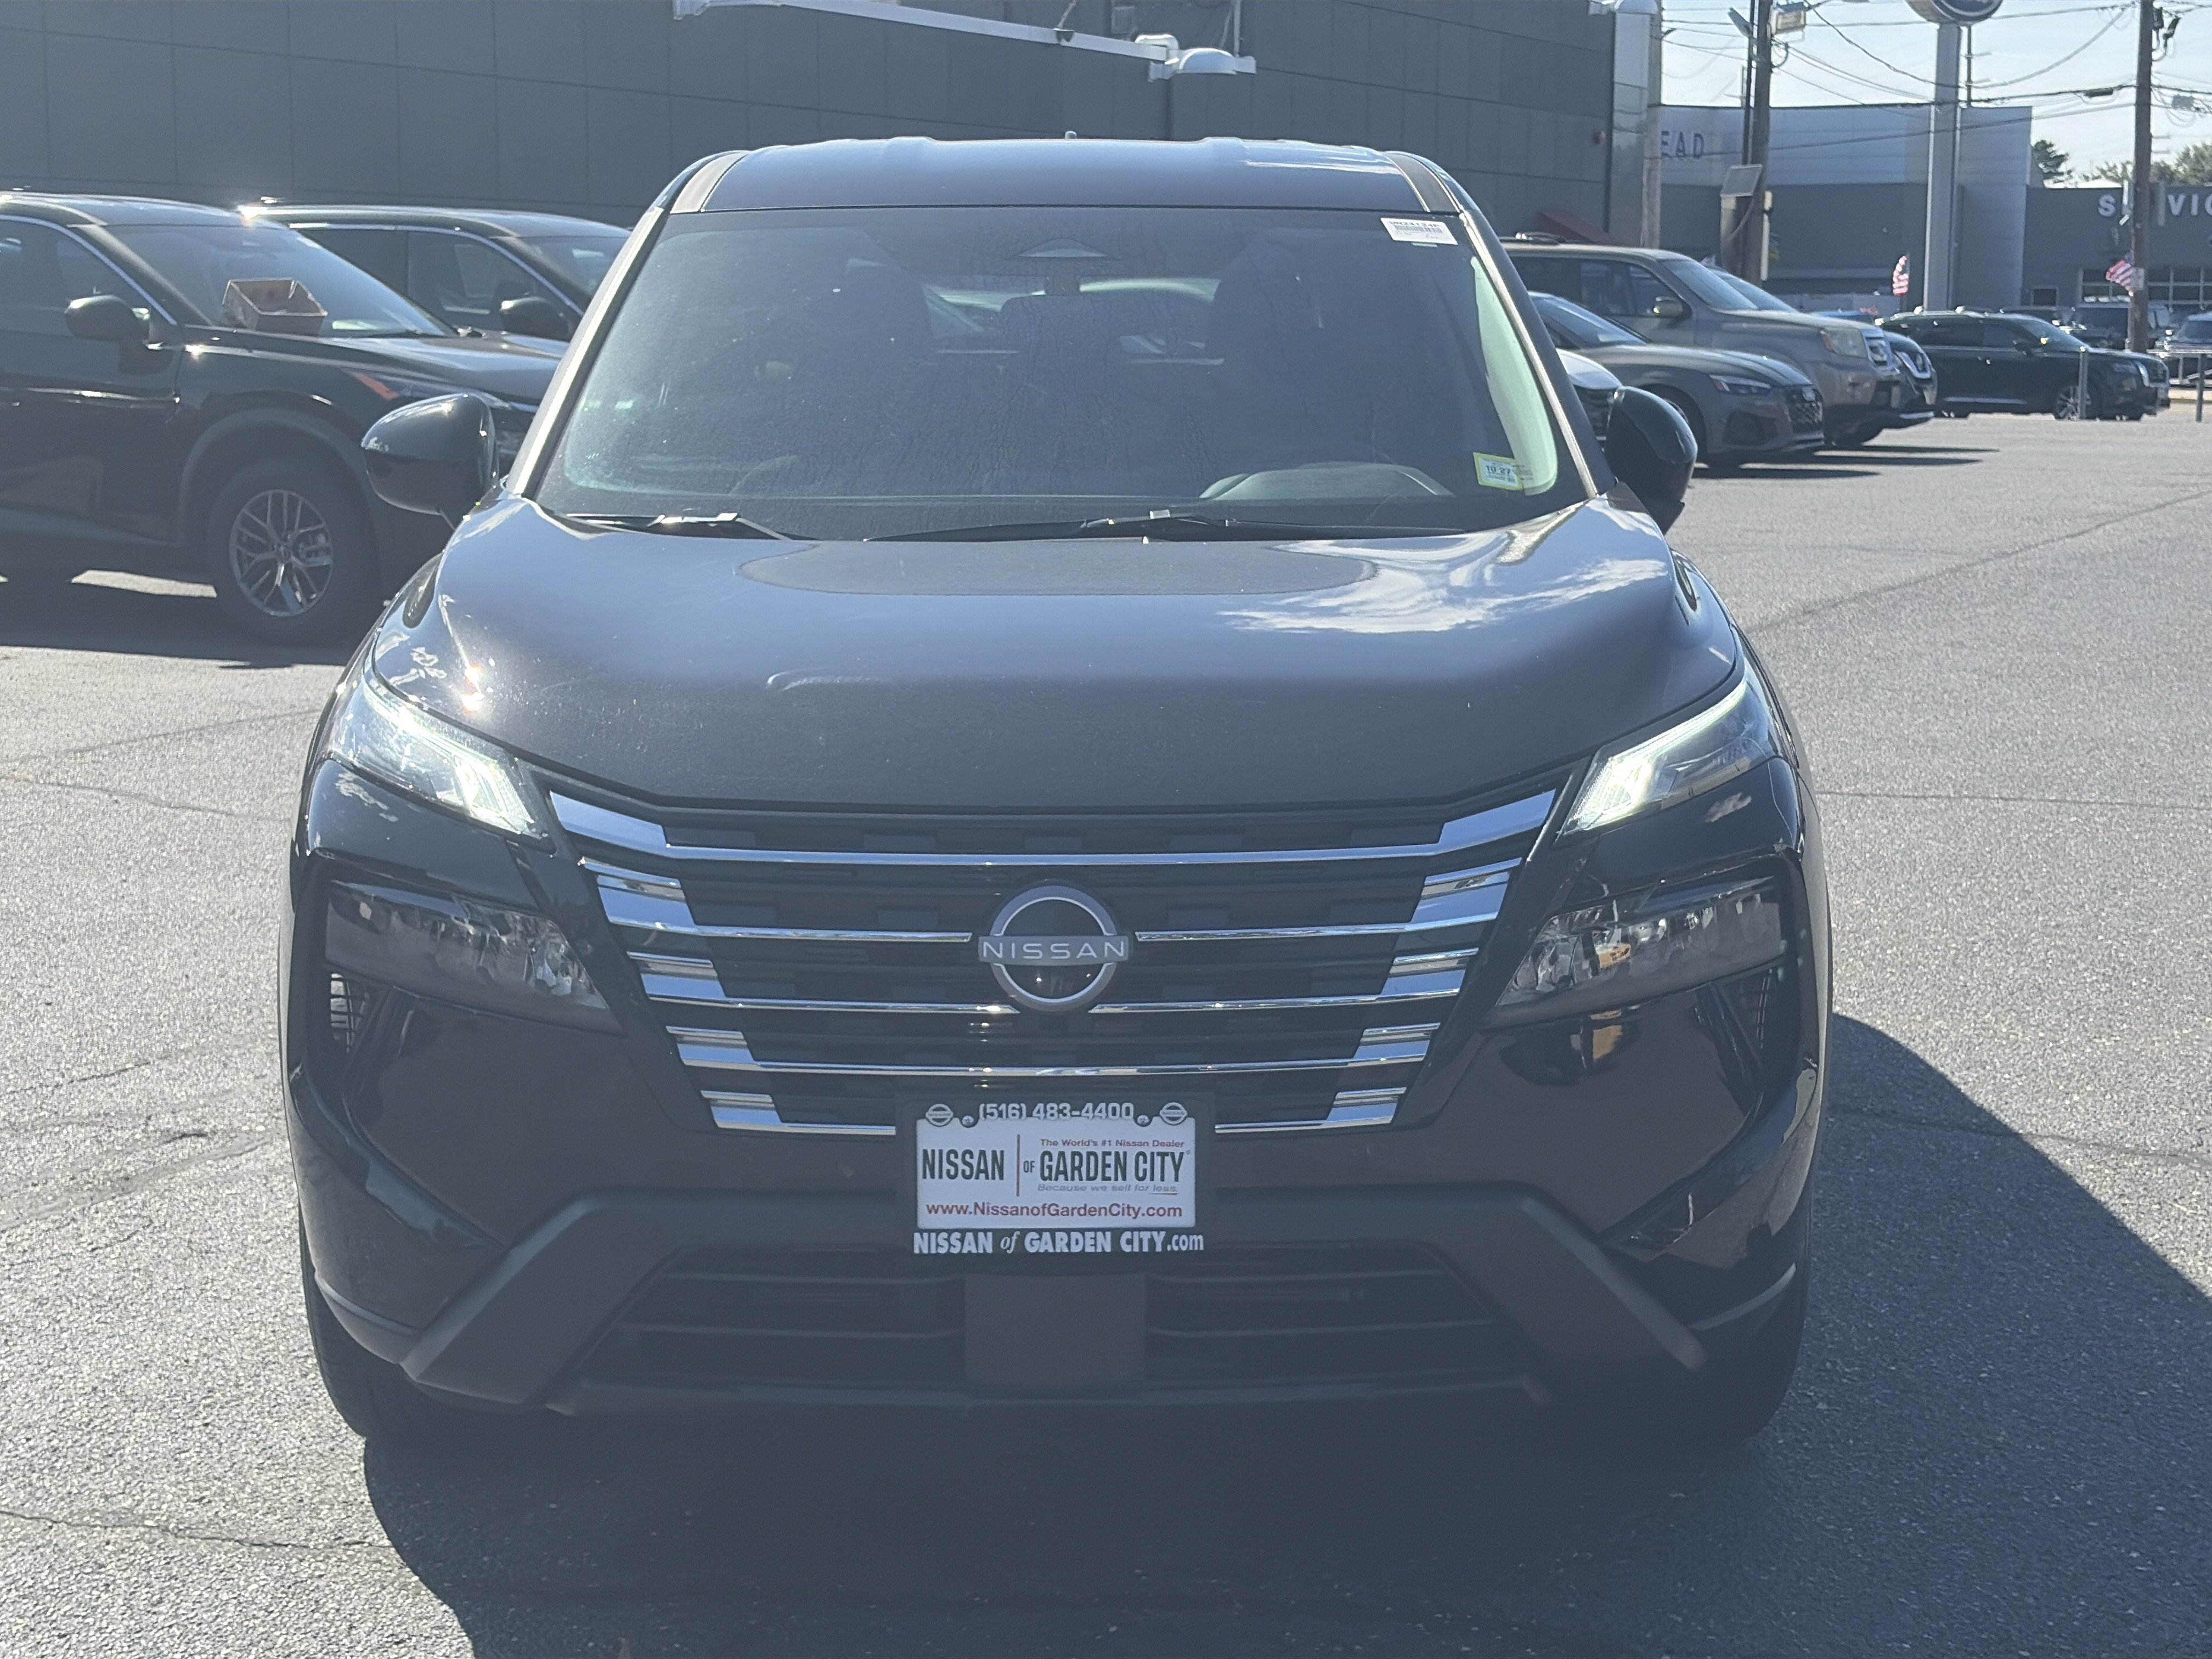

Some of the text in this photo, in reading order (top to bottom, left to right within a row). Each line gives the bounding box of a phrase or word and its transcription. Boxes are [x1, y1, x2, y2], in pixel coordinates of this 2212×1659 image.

[983, 941, 1125, 960] NISSAN
[979, 1102, 1135, 1120] (516) 483-4400
[1040, 1138, 1058, 1147] The
[1062, 1138, 1098, 1147] World's
[1115, 1139, 1149, 1148] Nissan
[1152, 1140, 1184, 1148] Dealer
[922, 1149, 1184, 1182] NISSAN OF GARDEN CITY
[1037, 1183, 1087, 1192] Because
[1111, 1183, 1131, 1192] sell
[1134, 1184, 1150, 1192] for
[1152, 1184, 1179, 1193] less.
[926, 1201, 1182, 1219] www.NissanofGardenCity.com
[913, 1231, 1204, 1254] NISSAN of GARDEN CITY.com
